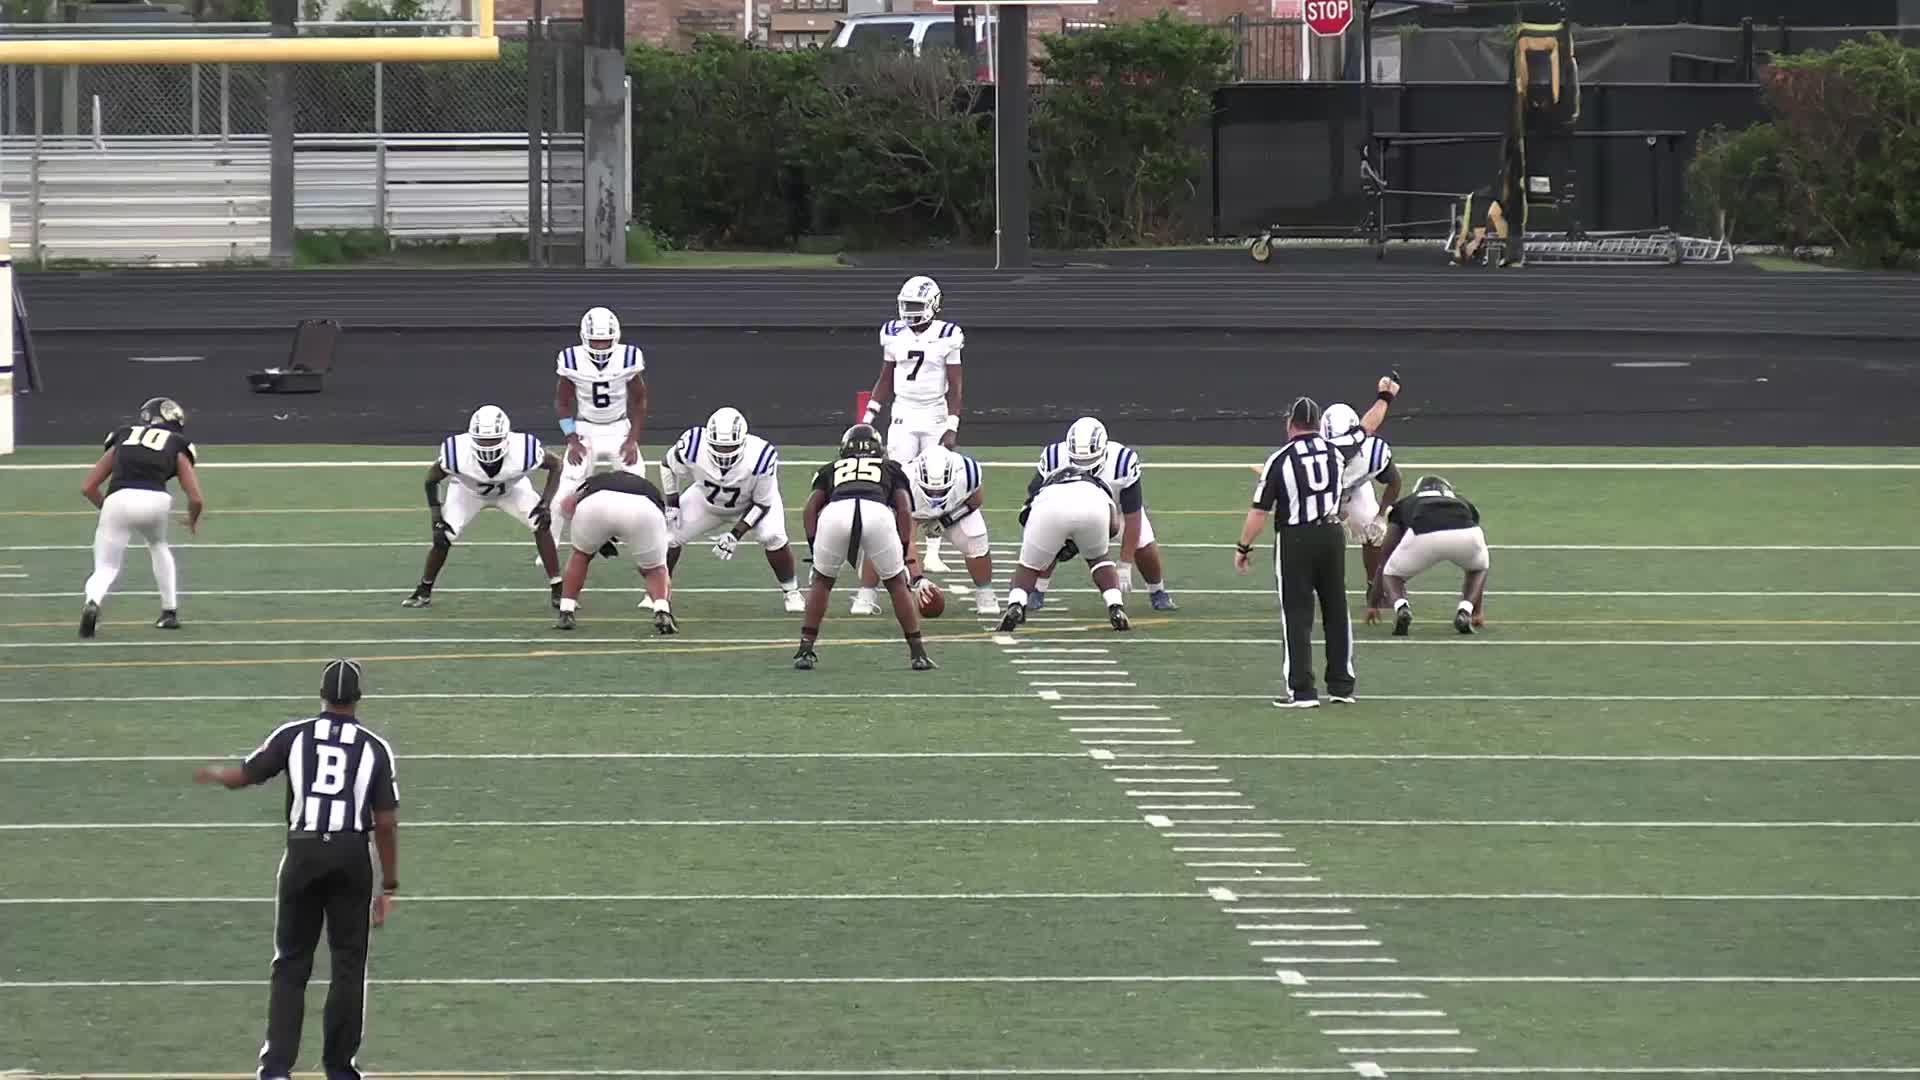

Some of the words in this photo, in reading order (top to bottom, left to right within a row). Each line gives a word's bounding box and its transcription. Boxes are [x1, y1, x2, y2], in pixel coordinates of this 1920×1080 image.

[1307, 1, 1349, 20] STOP
[906, 350, 925, 381] 7
[592, 381, 610, 408] 6
[121, 426, 172, 451] 10
[833, 457, 883, 488] 25
[1301, 453, 1330, 491] U
[477, 482, 506, 496] 71
[704, 480, 741, 508] 77
[311, 744, 347, 795] B
